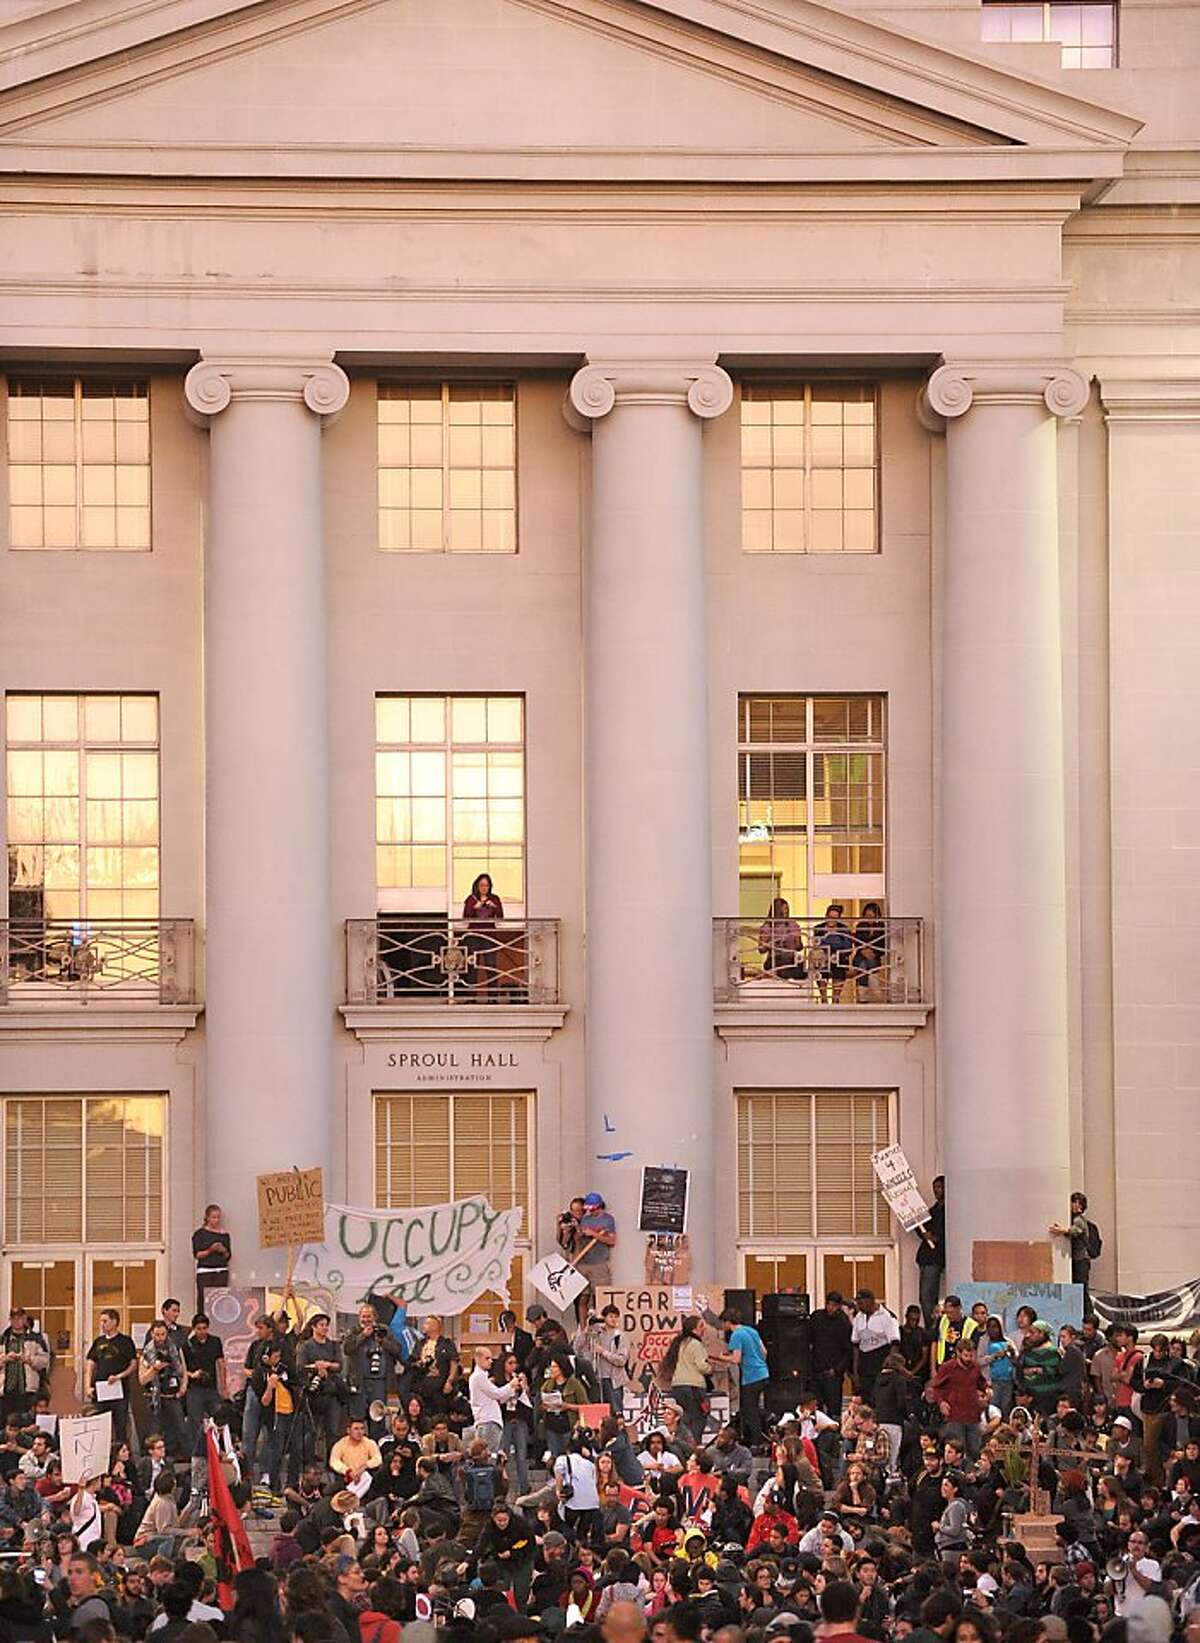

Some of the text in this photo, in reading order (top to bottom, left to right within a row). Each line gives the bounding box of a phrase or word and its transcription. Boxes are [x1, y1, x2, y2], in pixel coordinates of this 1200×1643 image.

[387, 1053, 520, 1067] SPROUL HALL
[265, 1180, 323, 1206] PUBLIC
[603, 1291, 670, 1312] TEAR
[648, 1336, 671, 1347] OCC
